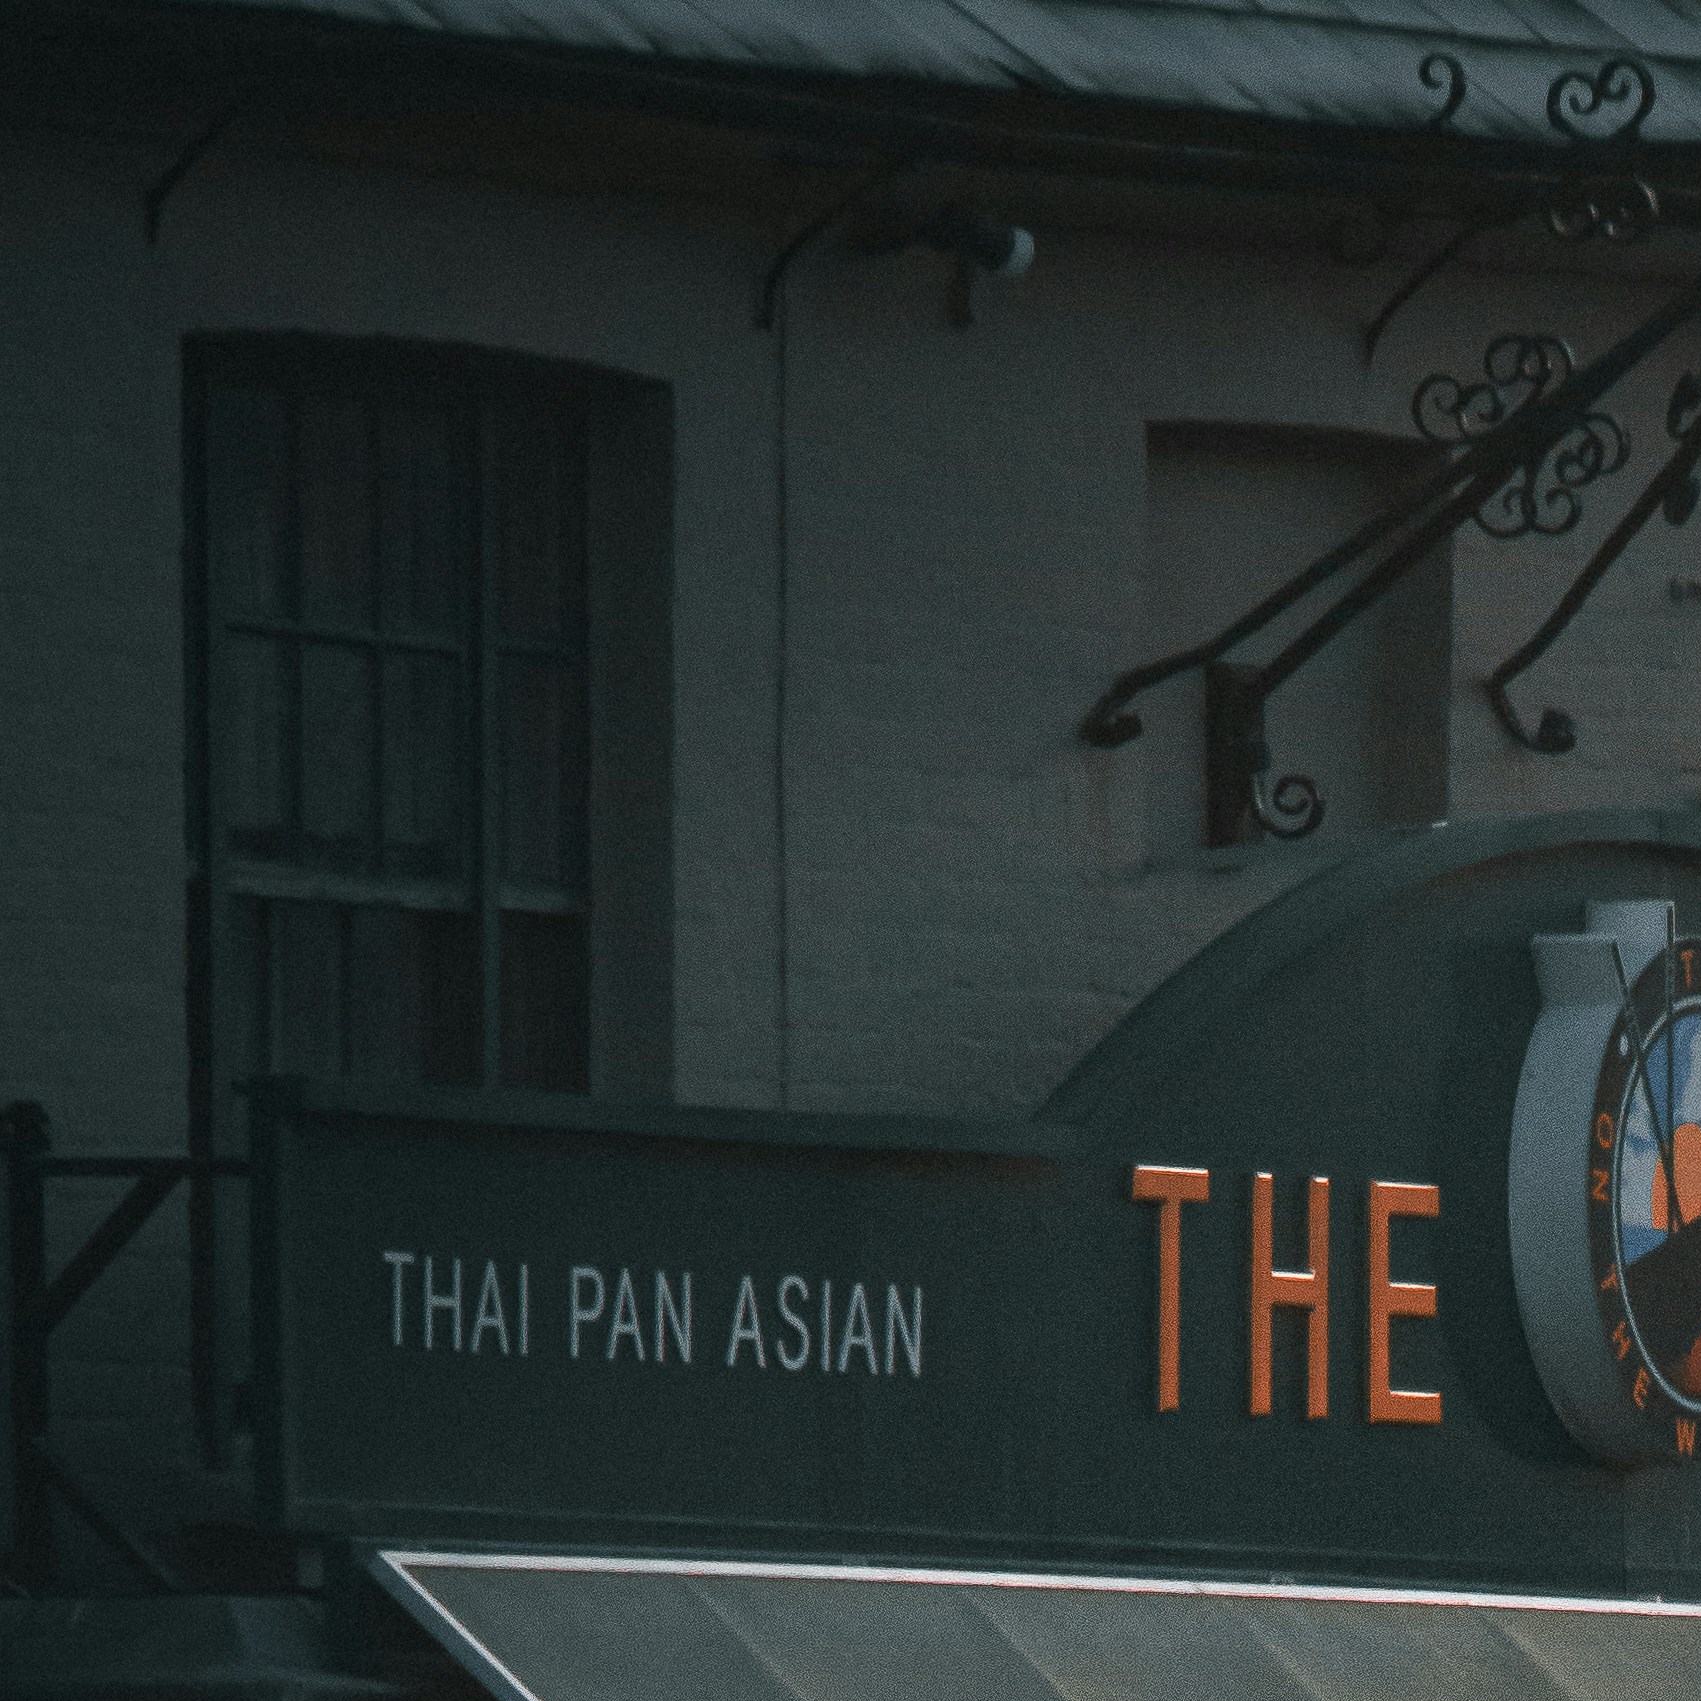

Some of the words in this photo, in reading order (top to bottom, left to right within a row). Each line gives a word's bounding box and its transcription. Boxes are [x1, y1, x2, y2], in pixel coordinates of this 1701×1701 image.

[1588, 1112, 1616, 1203] ON
[382, 1250, 532, 1358] THAI
[568, 1265, 694, 1366] PAN
[726, 1273, 924, 1379] ASIAN
[1131, 1164, 1443, 1425] THE
[1599, 1262, 1655, 1410] THE
